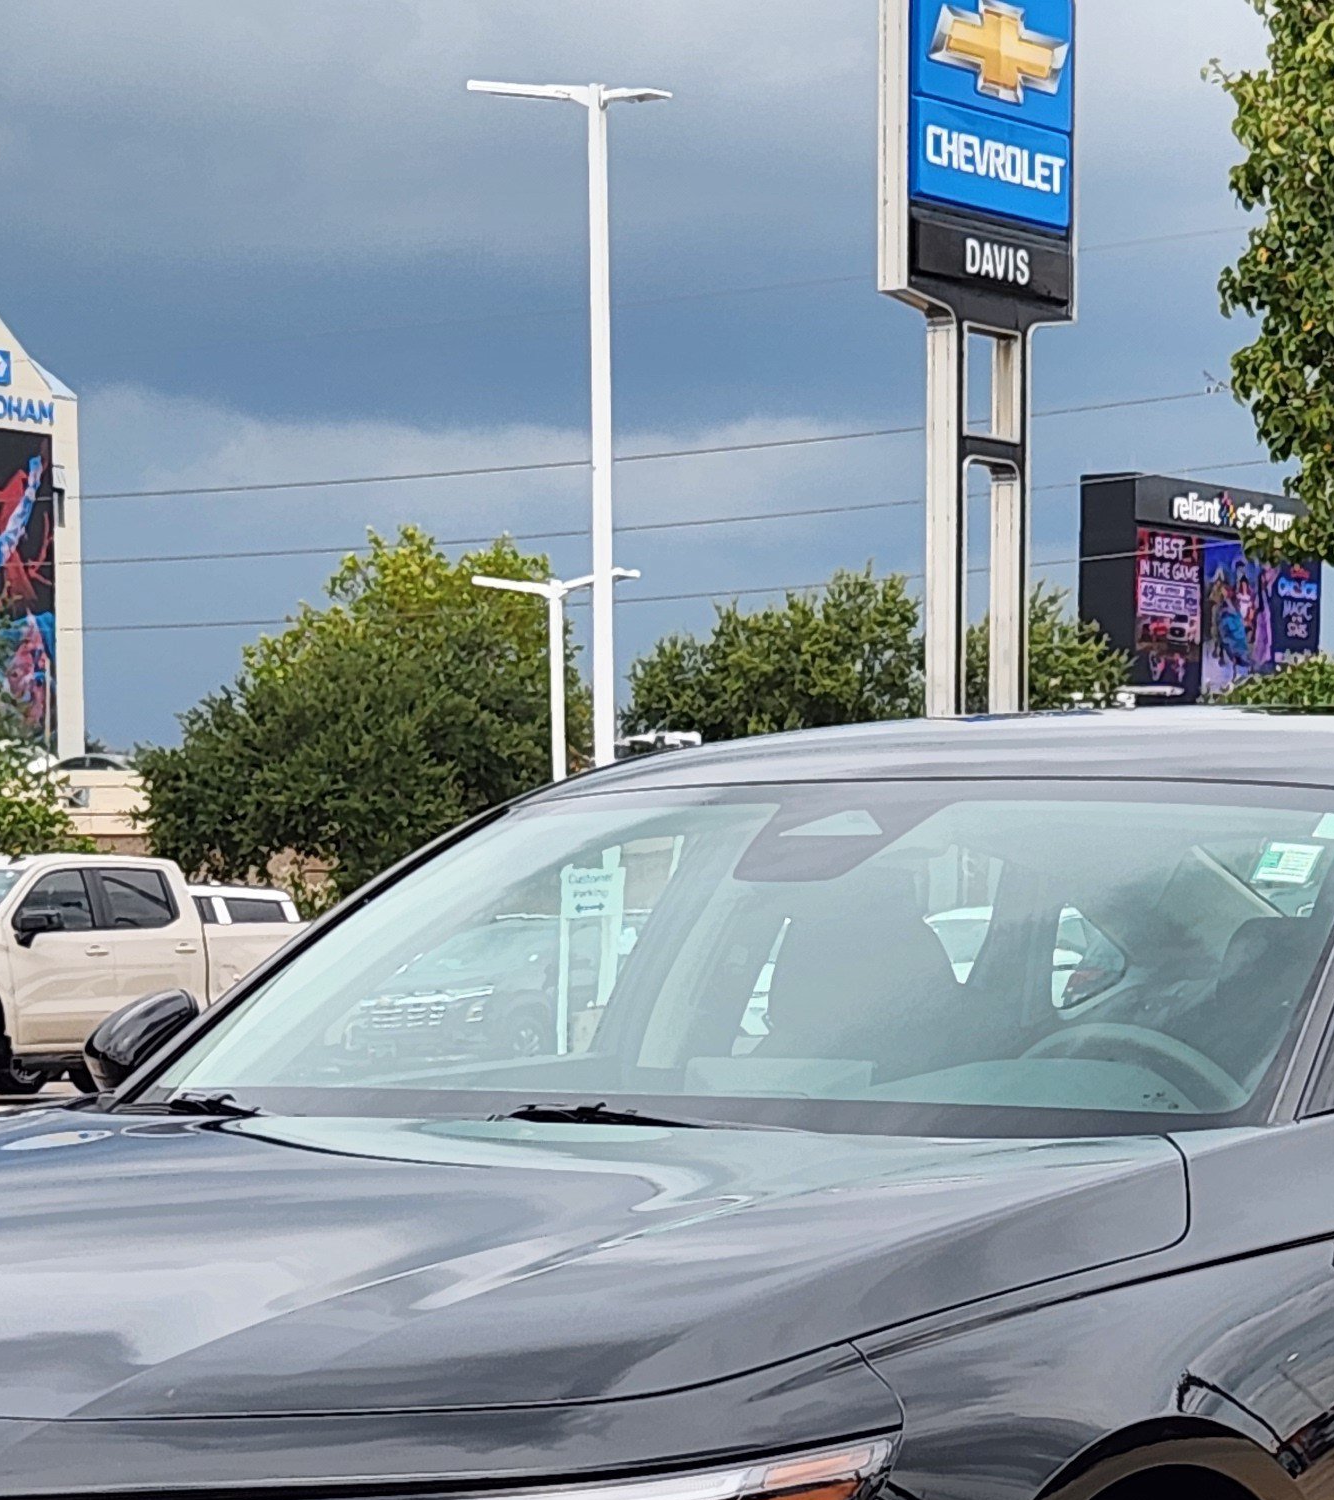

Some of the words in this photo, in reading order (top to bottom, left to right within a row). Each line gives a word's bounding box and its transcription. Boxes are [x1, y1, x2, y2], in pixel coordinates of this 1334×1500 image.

[926, 125, 1066, 195] CHEVROLET
[965, 237, 1030, 285] DAVIS
[1173, 492, 1221, 525] reliant
[1154, 536, 1185, 561] BEST
[1152, 561, 1171, 579] THE
